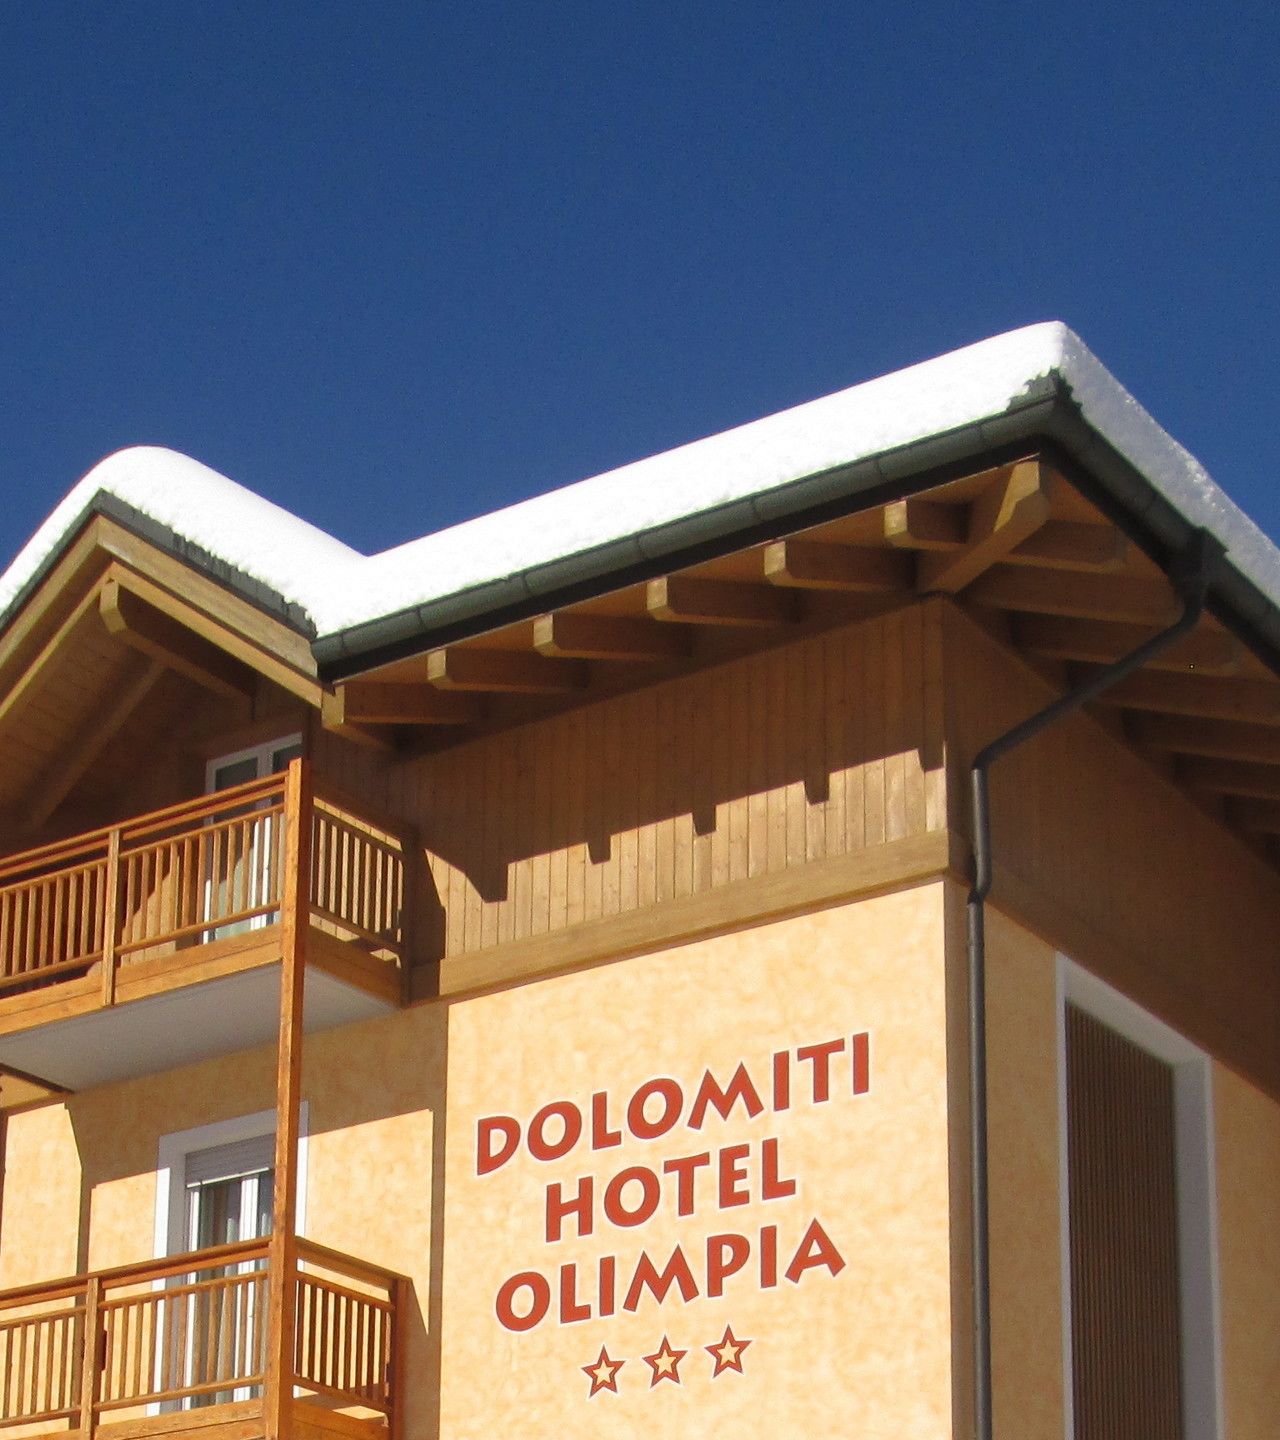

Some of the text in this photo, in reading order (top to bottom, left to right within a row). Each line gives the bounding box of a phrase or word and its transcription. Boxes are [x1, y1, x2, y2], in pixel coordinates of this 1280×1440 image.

[477, 1032, 869, 1175] DOLOMITI
[545, 1137, 796, 1243] HOTEL
[495, 1217, 846, 1332] OLIMPIA
